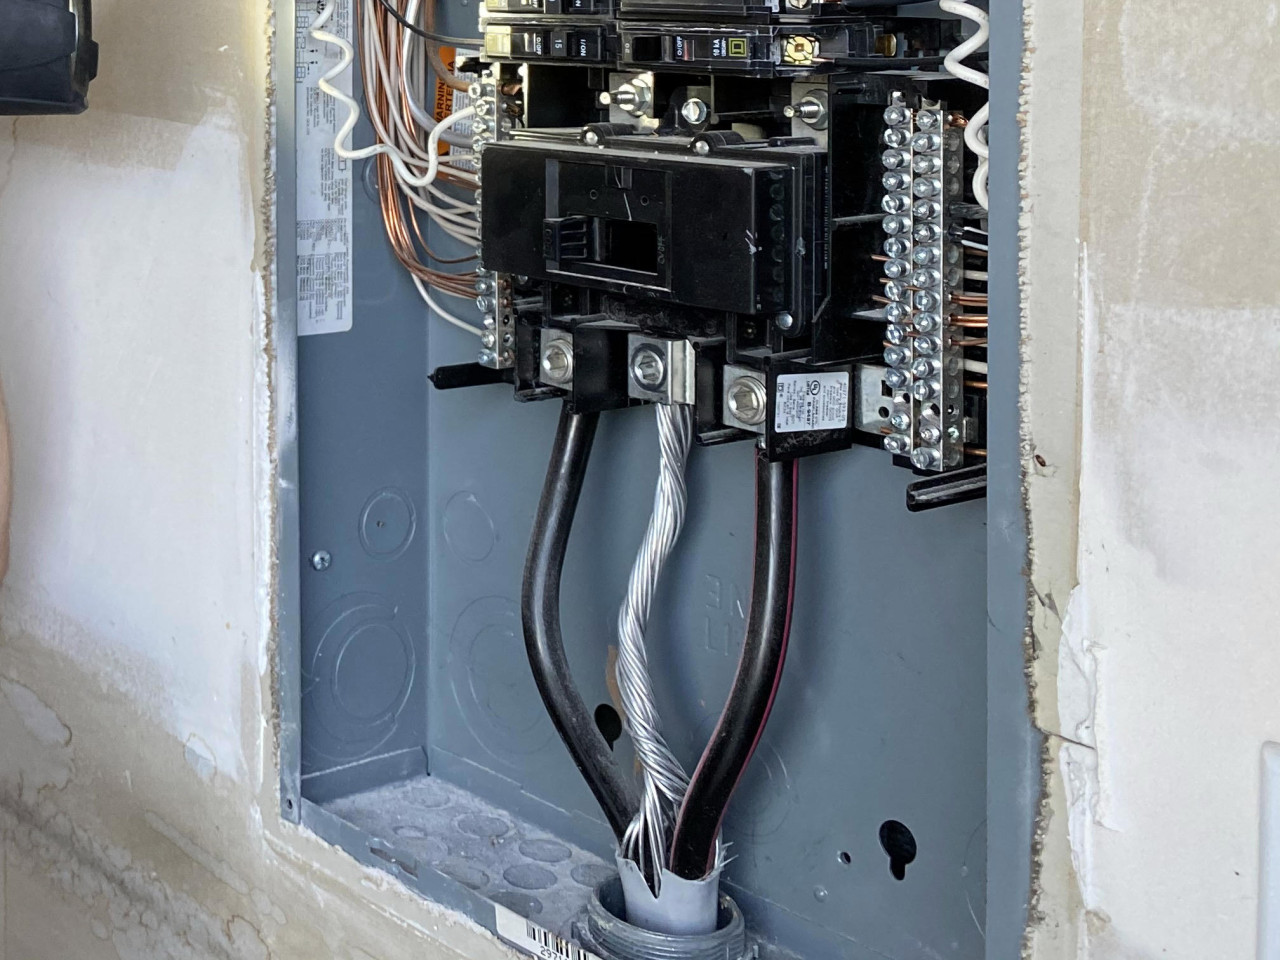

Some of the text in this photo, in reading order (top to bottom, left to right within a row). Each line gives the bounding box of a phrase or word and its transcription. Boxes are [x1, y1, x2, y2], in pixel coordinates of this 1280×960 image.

[555, 39, 562, 48] 15
[713, 39, 720, 57] 10 kA
